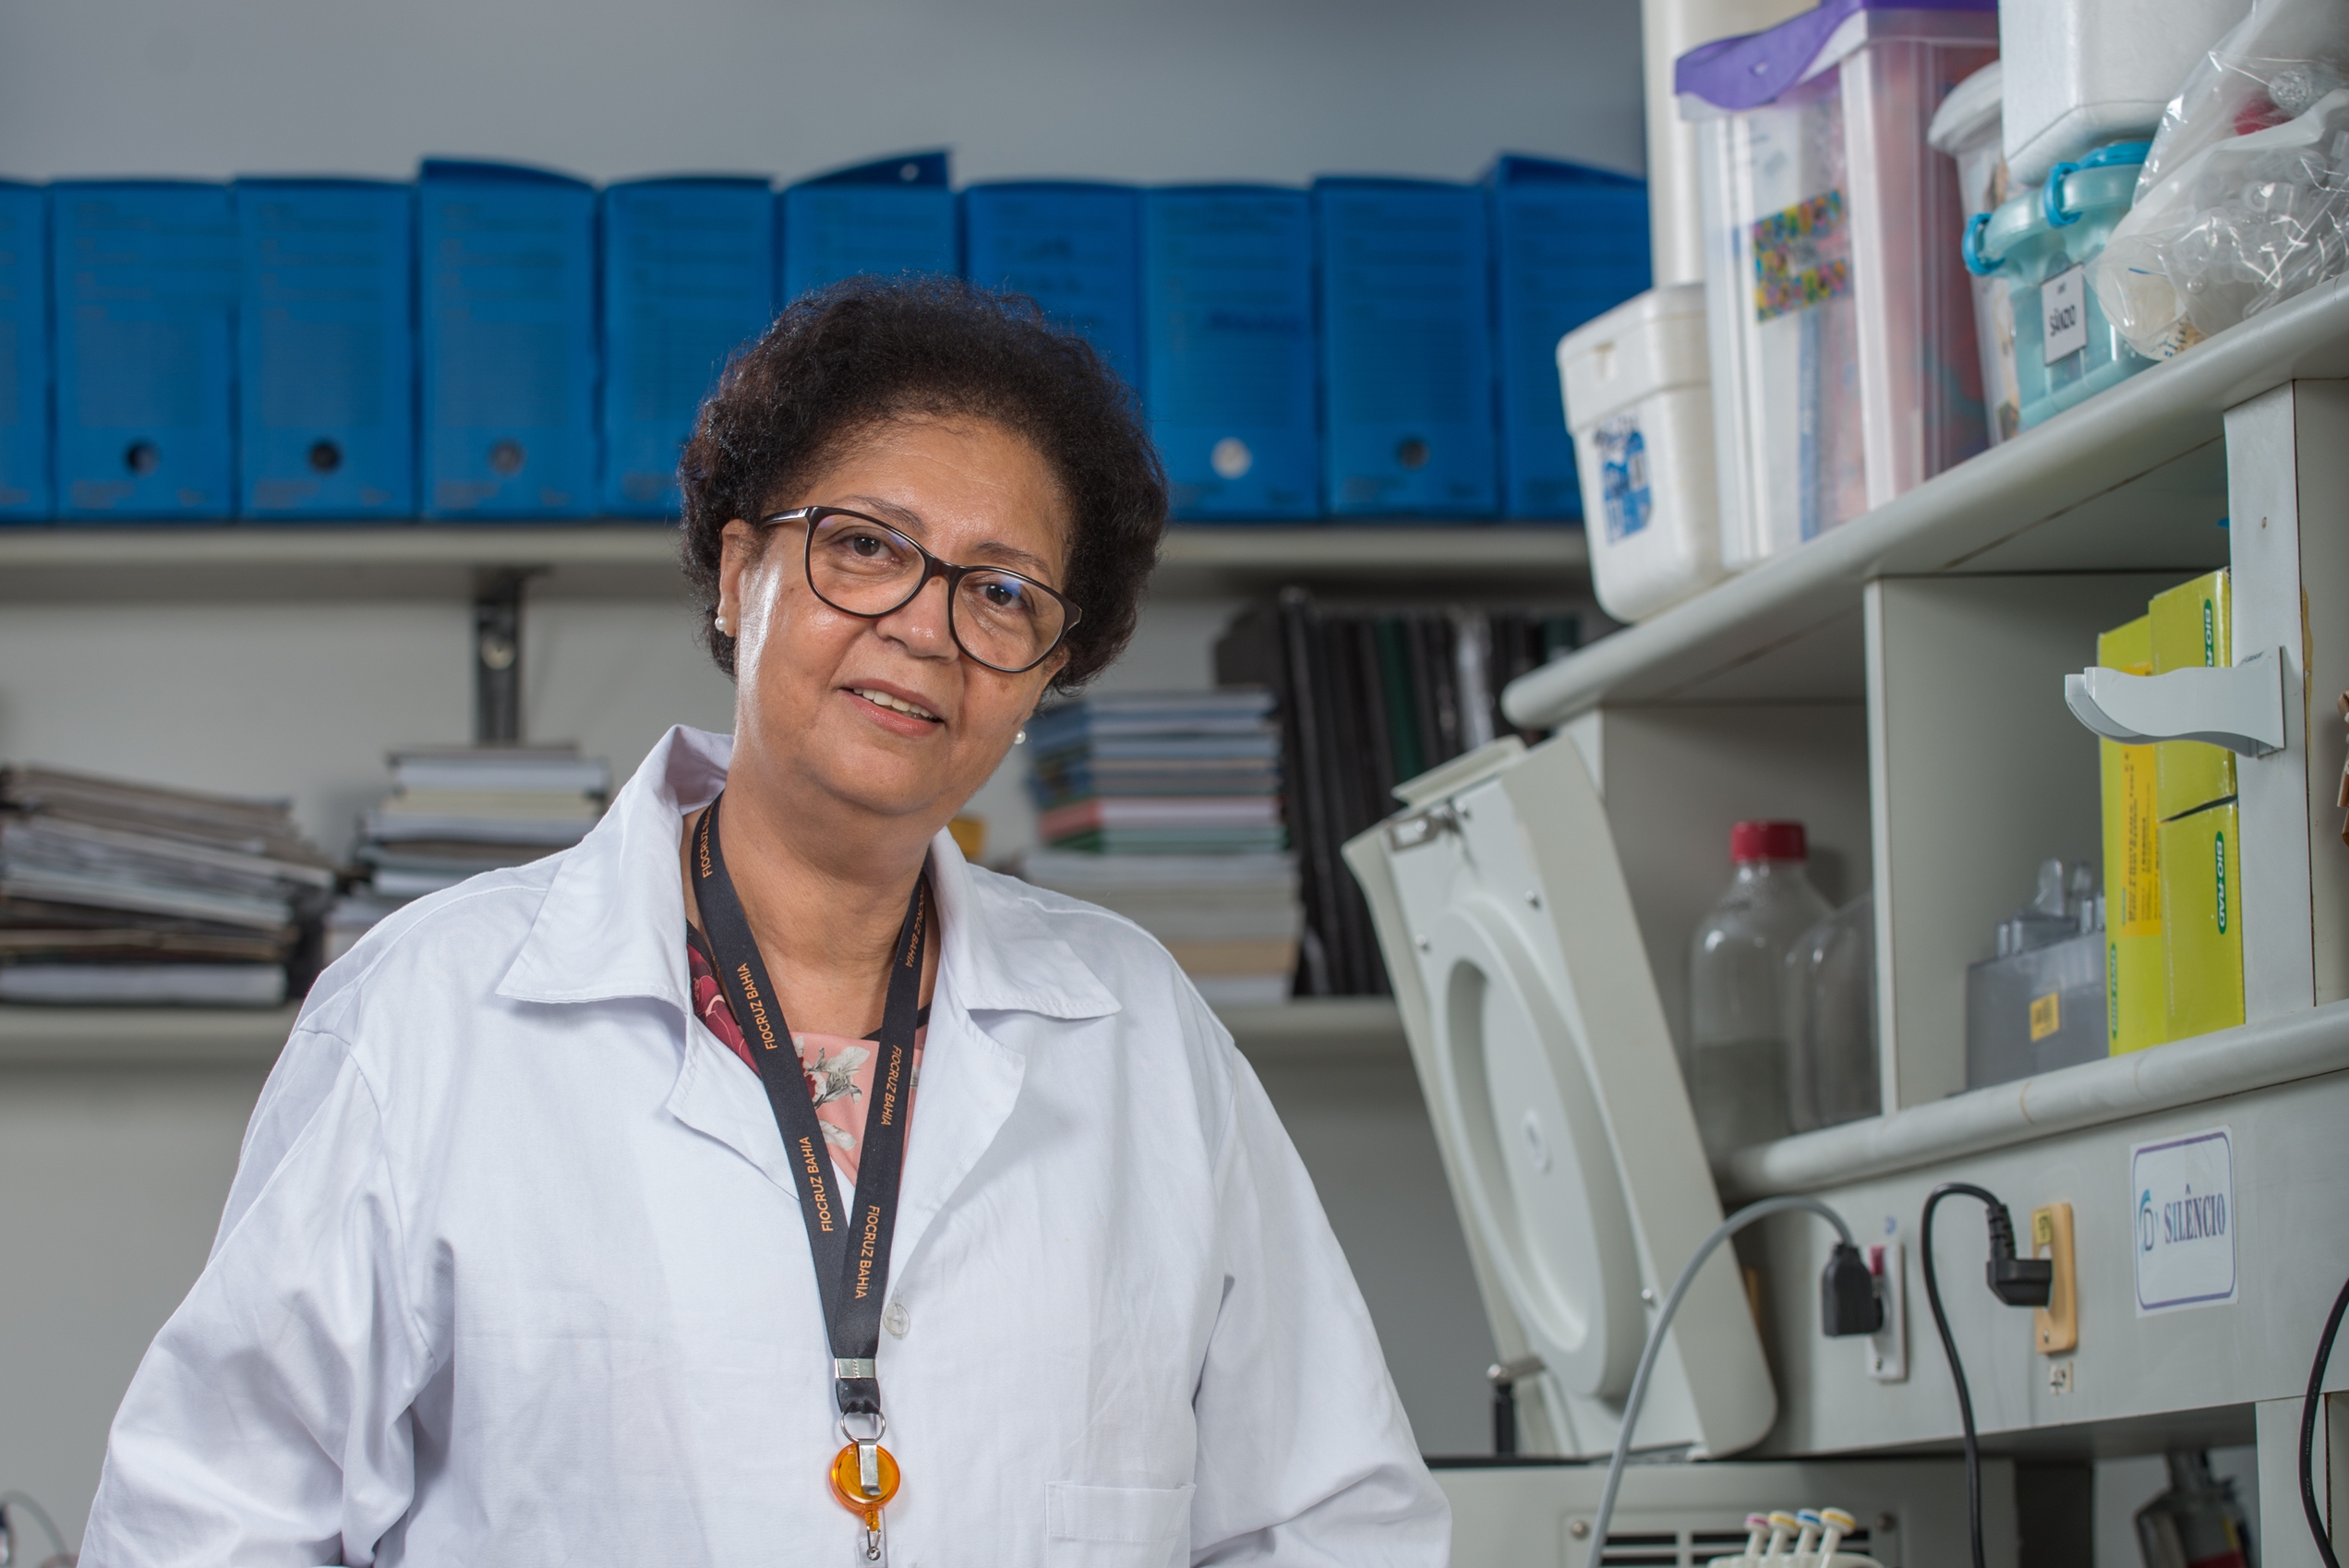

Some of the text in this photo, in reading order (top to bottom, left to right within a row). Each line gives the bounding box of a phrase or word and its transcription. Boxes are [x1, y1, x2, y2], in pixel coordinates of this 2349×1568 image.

[700, 827, 713, 878] FIOCRUZ
[905, 933, 919, 968] BAHIA
[737, 962, 777, 1050] FIOCRUZ BAHIA
[881, 1044, 902, 1126] FIOCRUZ BAHIA
[799, 1136, 834, 1232] FIOCRUZ BAHIA
[2164, 1183, 2226, 1244] SILÊNCIO
[855, 1205, 881, 1299] FIOCRUZ BAHIA
